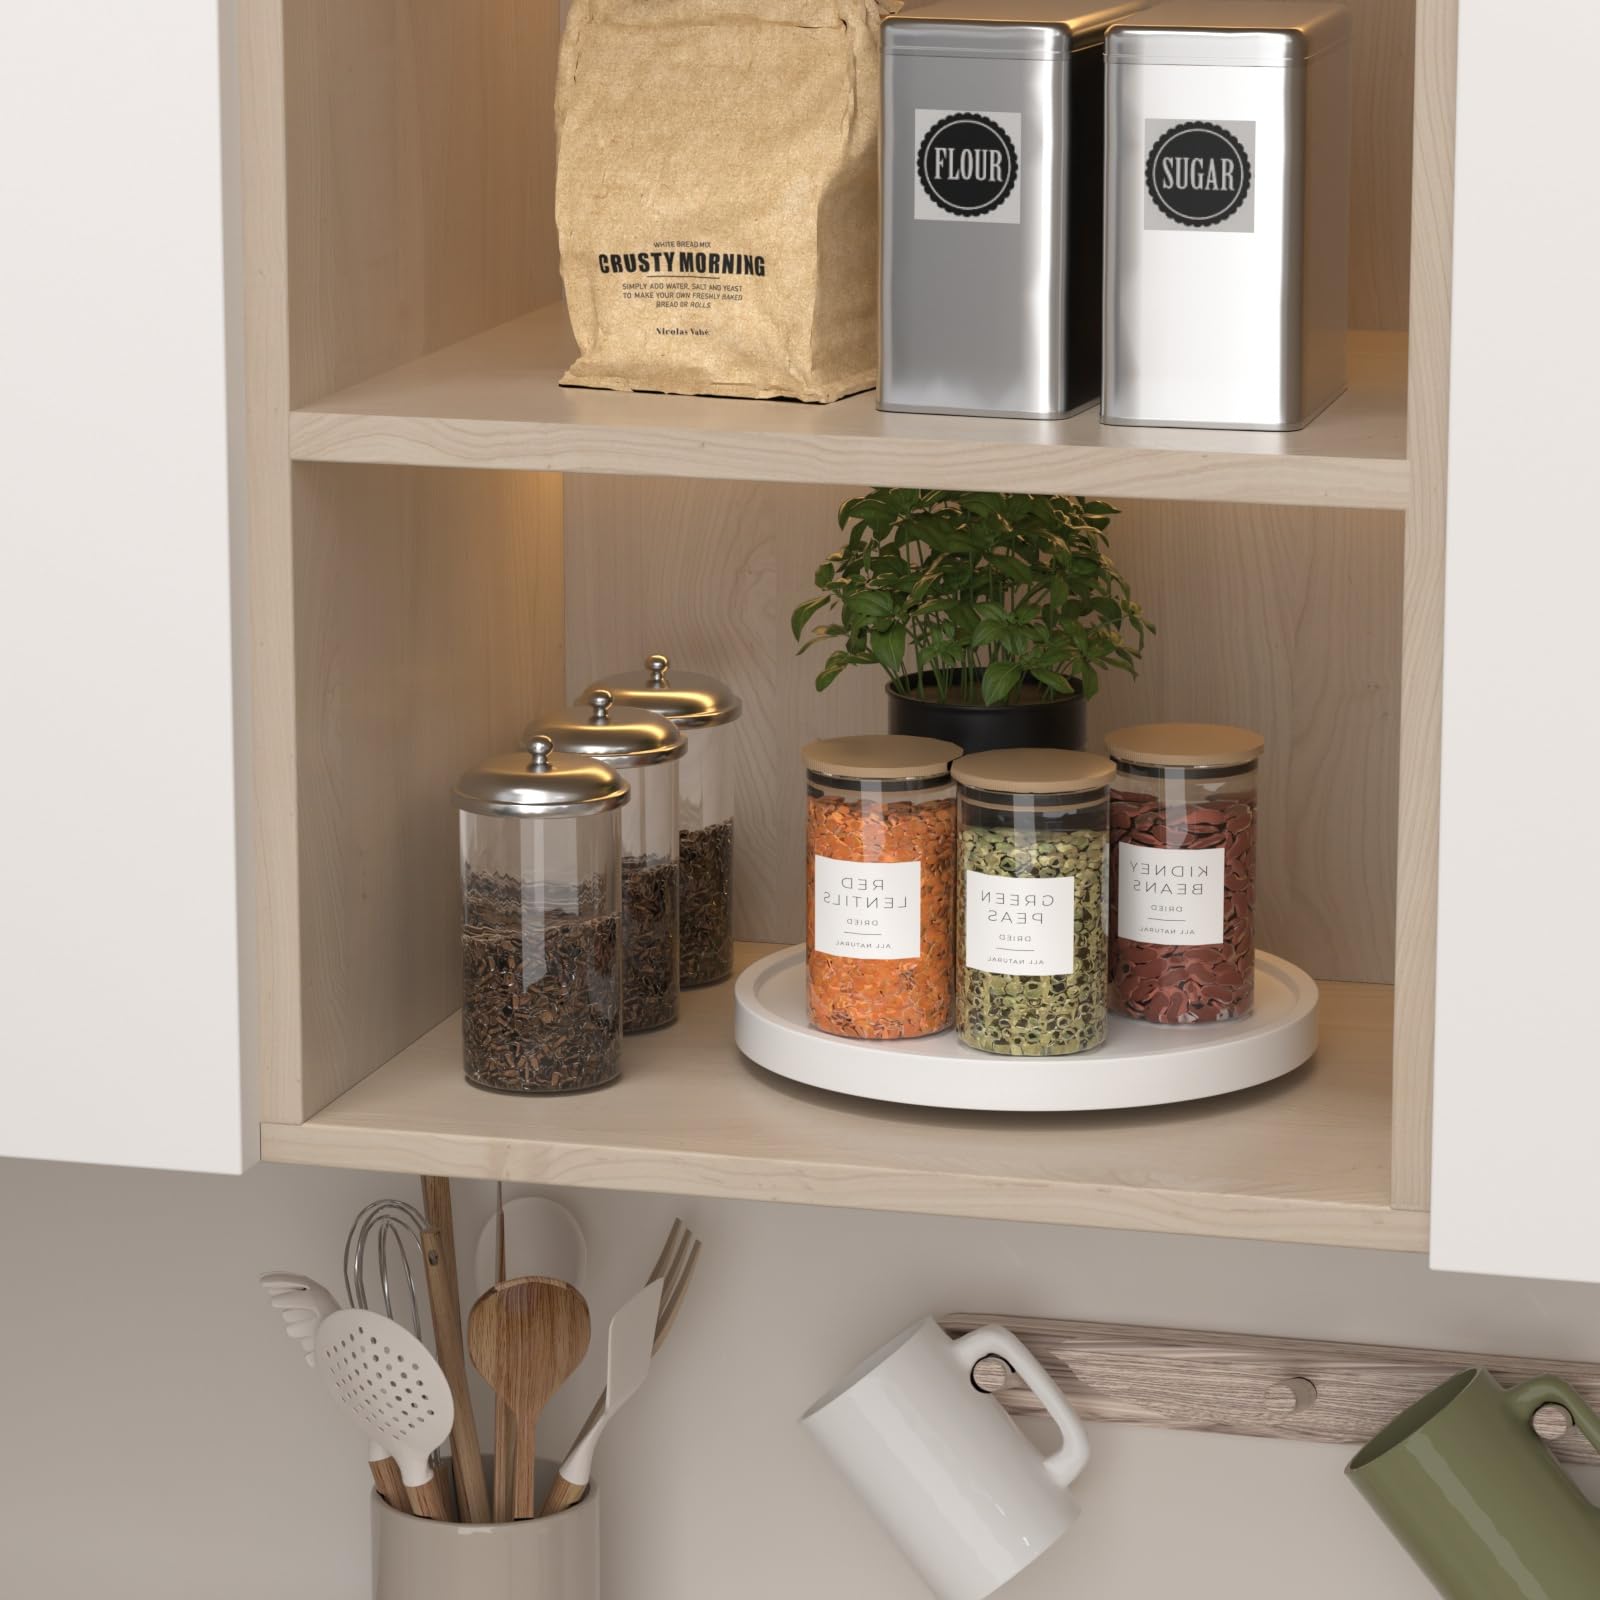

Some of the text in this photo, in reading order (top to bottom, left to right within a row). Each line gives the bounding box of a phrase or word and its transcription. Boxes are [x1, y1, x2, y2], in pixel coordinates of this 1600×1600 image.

[934, 147, 1003, 182] FLOUR
[1162, 156, 1235, 191] SUGAR
[653, 240, 712, 249] WHITE BREAD MIX
[599, 252, 766, 277] CRUSTY MORNING
[691, 283, 707, 291] SALT
[692, 292, 720, 300] FRESHLY
[721, 293, 743, 301] BAKED
[656, 327, 689, 335] Nicolas
